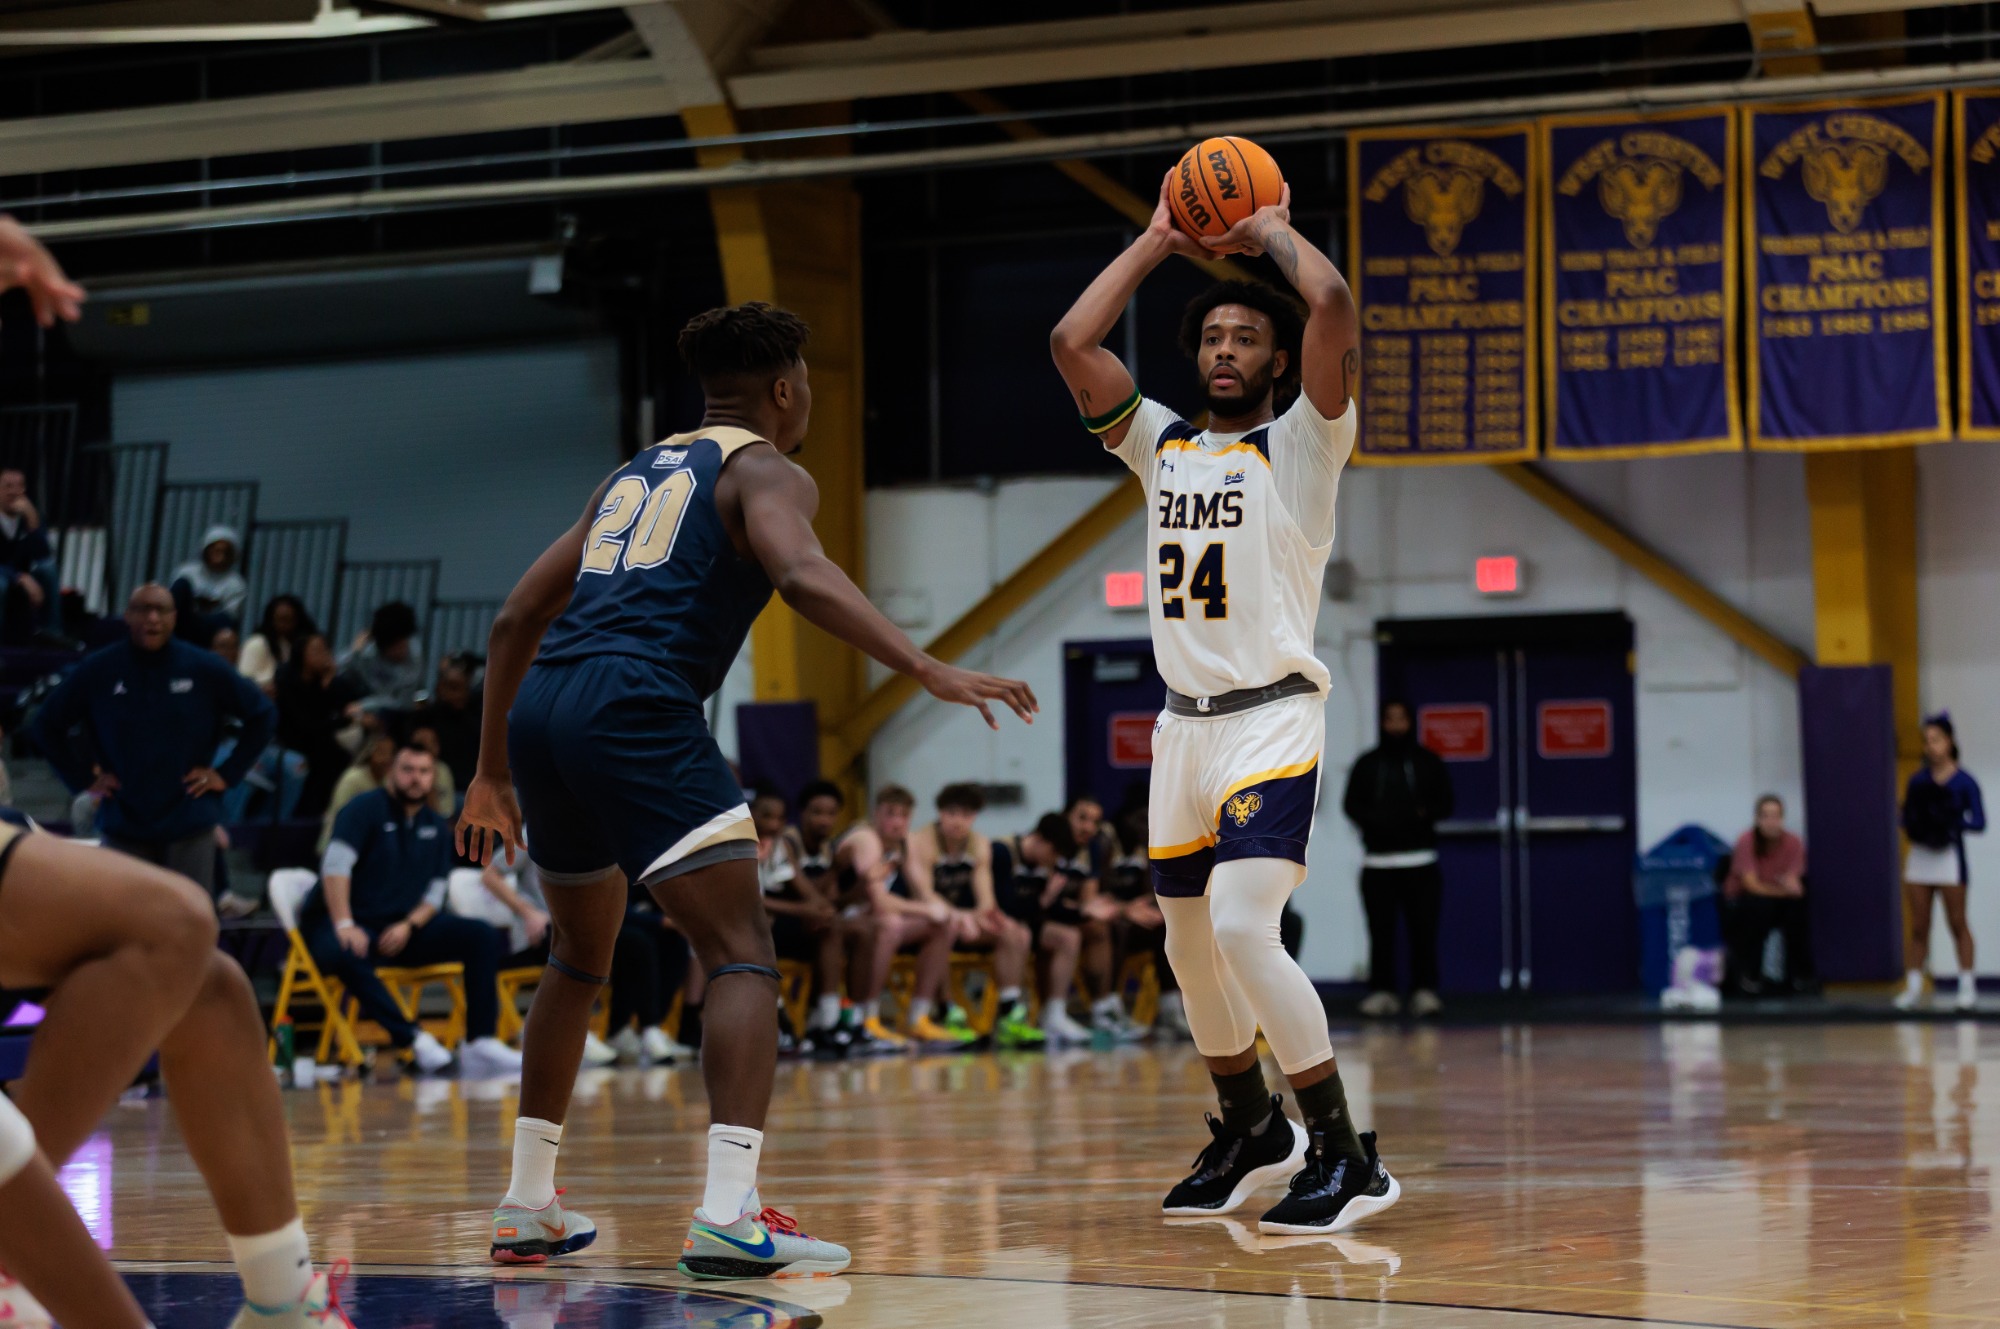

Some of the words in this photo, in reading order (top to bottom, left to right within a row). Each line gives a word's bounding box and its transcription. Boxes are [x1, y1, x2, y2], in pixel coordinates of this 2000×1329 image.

[1208, 150, 1239, 200] NCAA
[1605, 269, 1678, 297] PSAC
[1809, 253, 1884, 282] PSAC
[1408, 276, 1479, 301] PSAC
[1762, 277, 1929, 312] CHAMPIONS
[1364, 302, 1522, 331] CHAMPIONS
[1559, 292, 1723, 326] CHAMPIONS
[577, 468, 697, 579] 20
[1159, 490, 1243, 530] RAMS
[1159, 541, 1228, 621] 24
